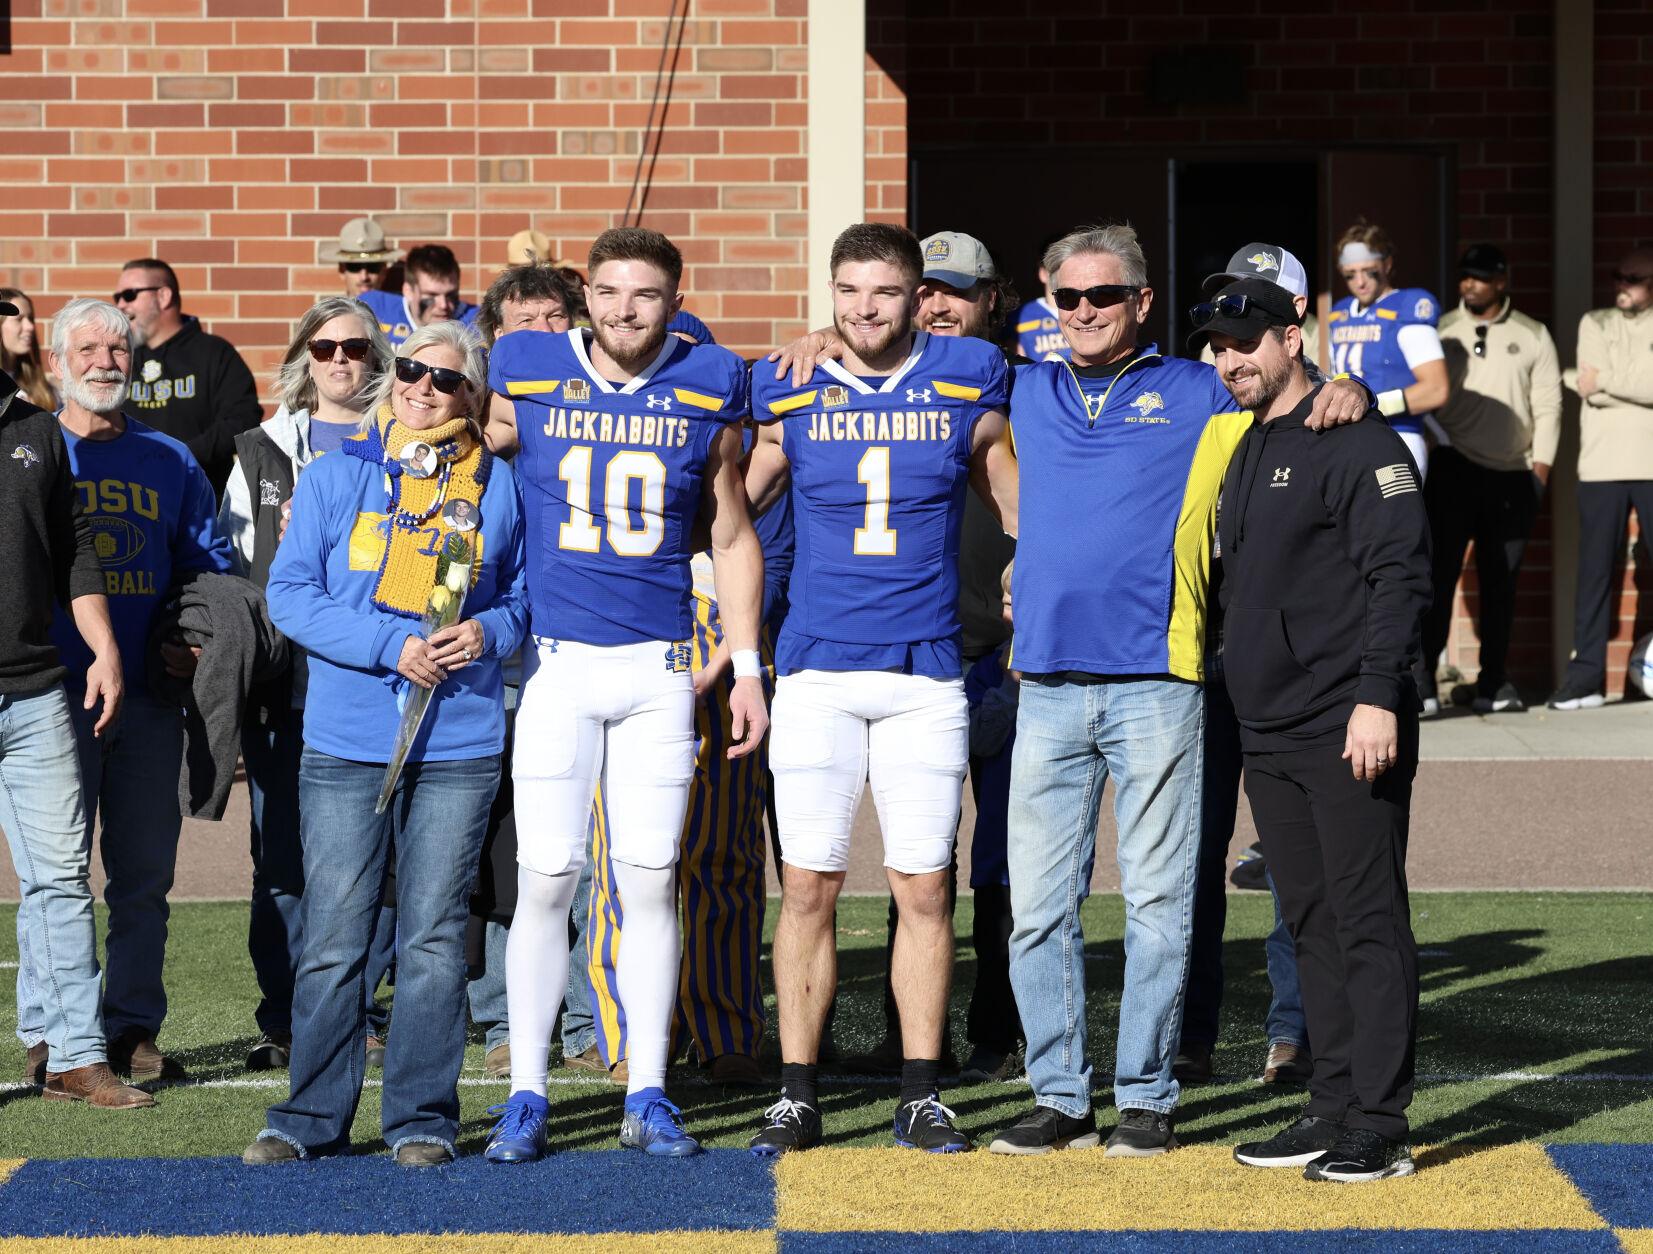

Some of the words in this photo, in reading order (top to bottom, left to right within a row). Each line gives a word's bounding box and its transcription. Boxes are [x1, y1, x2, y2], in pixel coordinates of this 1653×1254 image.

[543, 407, 689, 448] JACKRABBITS
[807, 410, 951, 441] JACKRABBITS
[558, 445, 667, 557] 10
[853, 446, 897, 556] 1
